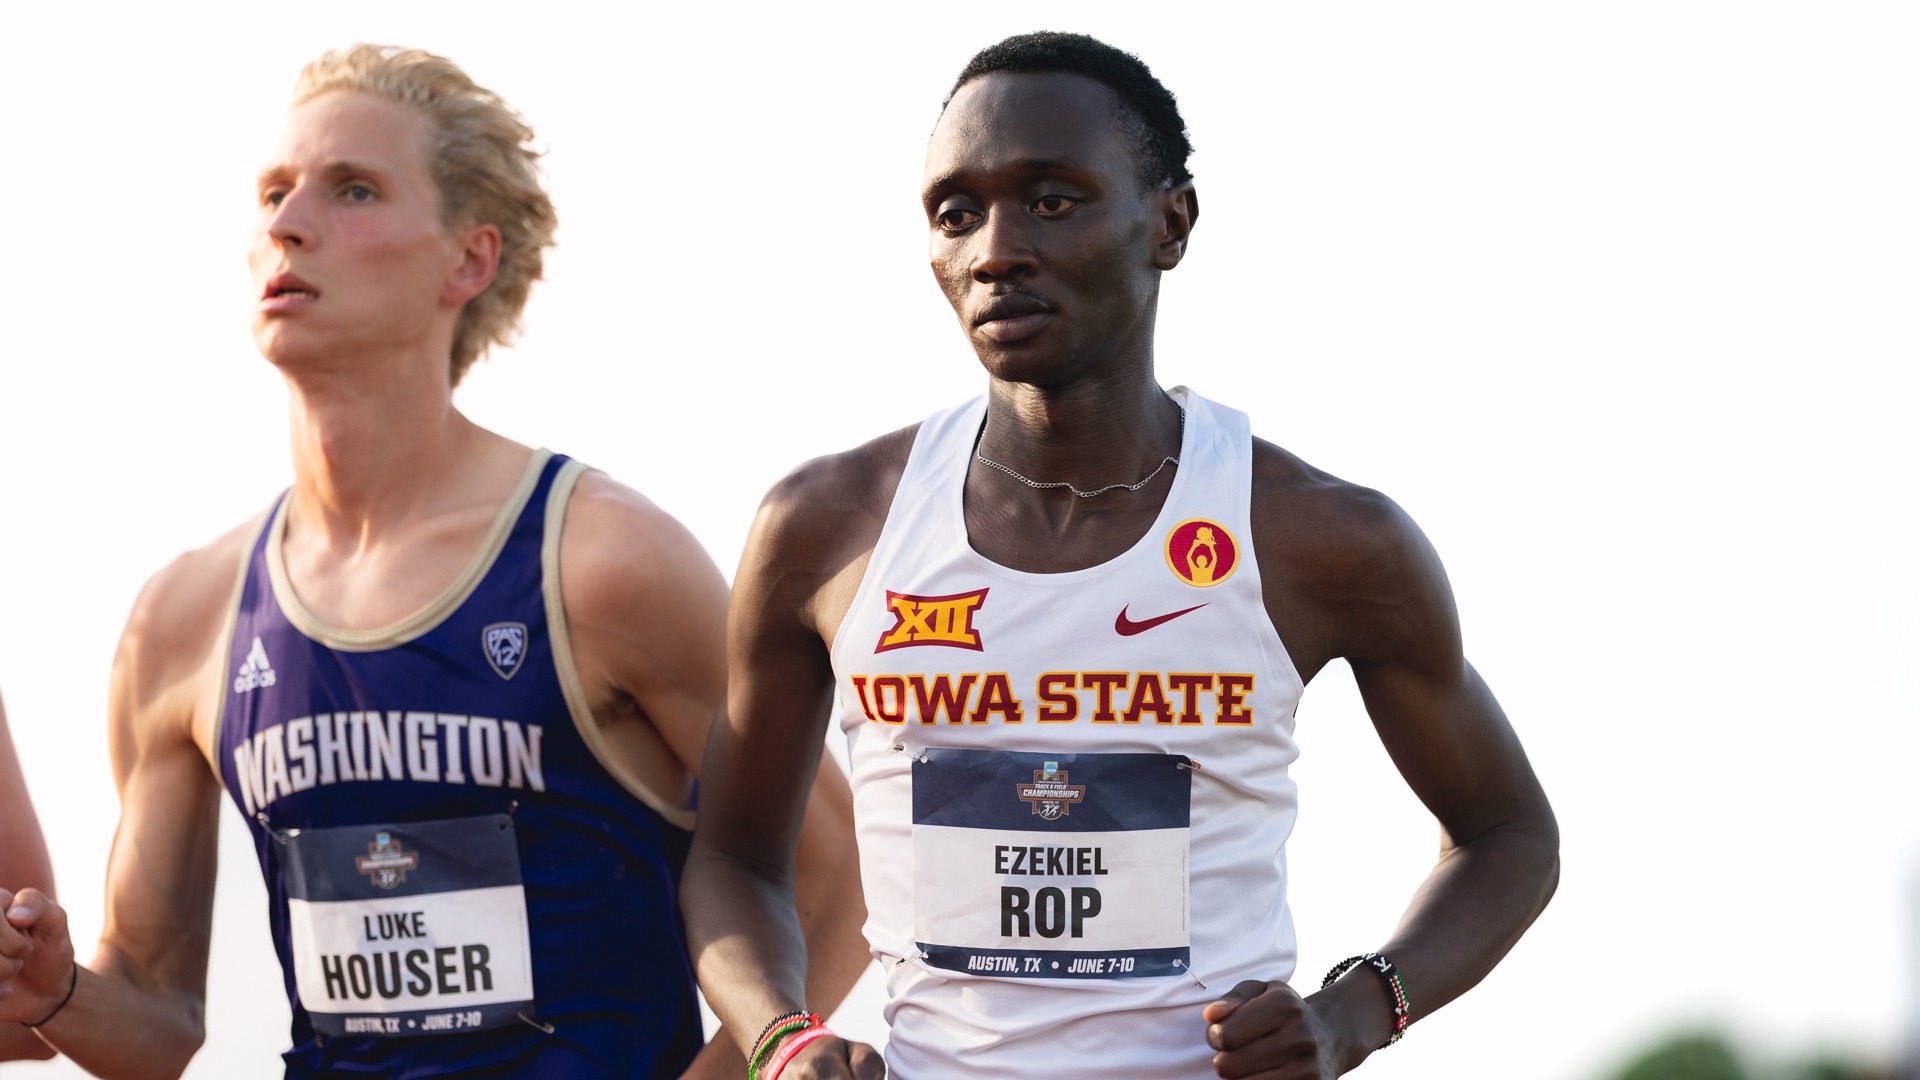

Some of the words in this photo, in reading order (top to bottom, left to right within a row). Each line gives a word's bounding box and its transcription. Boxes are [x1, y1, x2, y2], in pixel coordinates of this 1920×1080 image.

[880, 593, 983, 647] XII
[487, 627, 523, 656] PAC
[496, 646, 517, 666] 12
[851, 672, 1023, 726] IOWA
[1037, 671, 1255, 727] STATE
[233, 710, 546, 817] WASHINGTON
[1023, 789, 1079, 798] CHAMPIONSHIPS
[994, 845, 1109, 876] EZEKIEL
[363, 911, 427, 941] LUKE
[1000, 886, 1102, 938] ROP
[321, 943, 493, 1000] HOUSER
[967, 955, 1019, 973] AUSTIN,
[1024, 957, 1042, 973] TX
[1067, 958, 1105, 974] JUNE
[1108, 957, 1135, 973] 7-10
[421, 1013, 454, 1031] JUNE
[455, 1010, 482, 1028] 7-10
